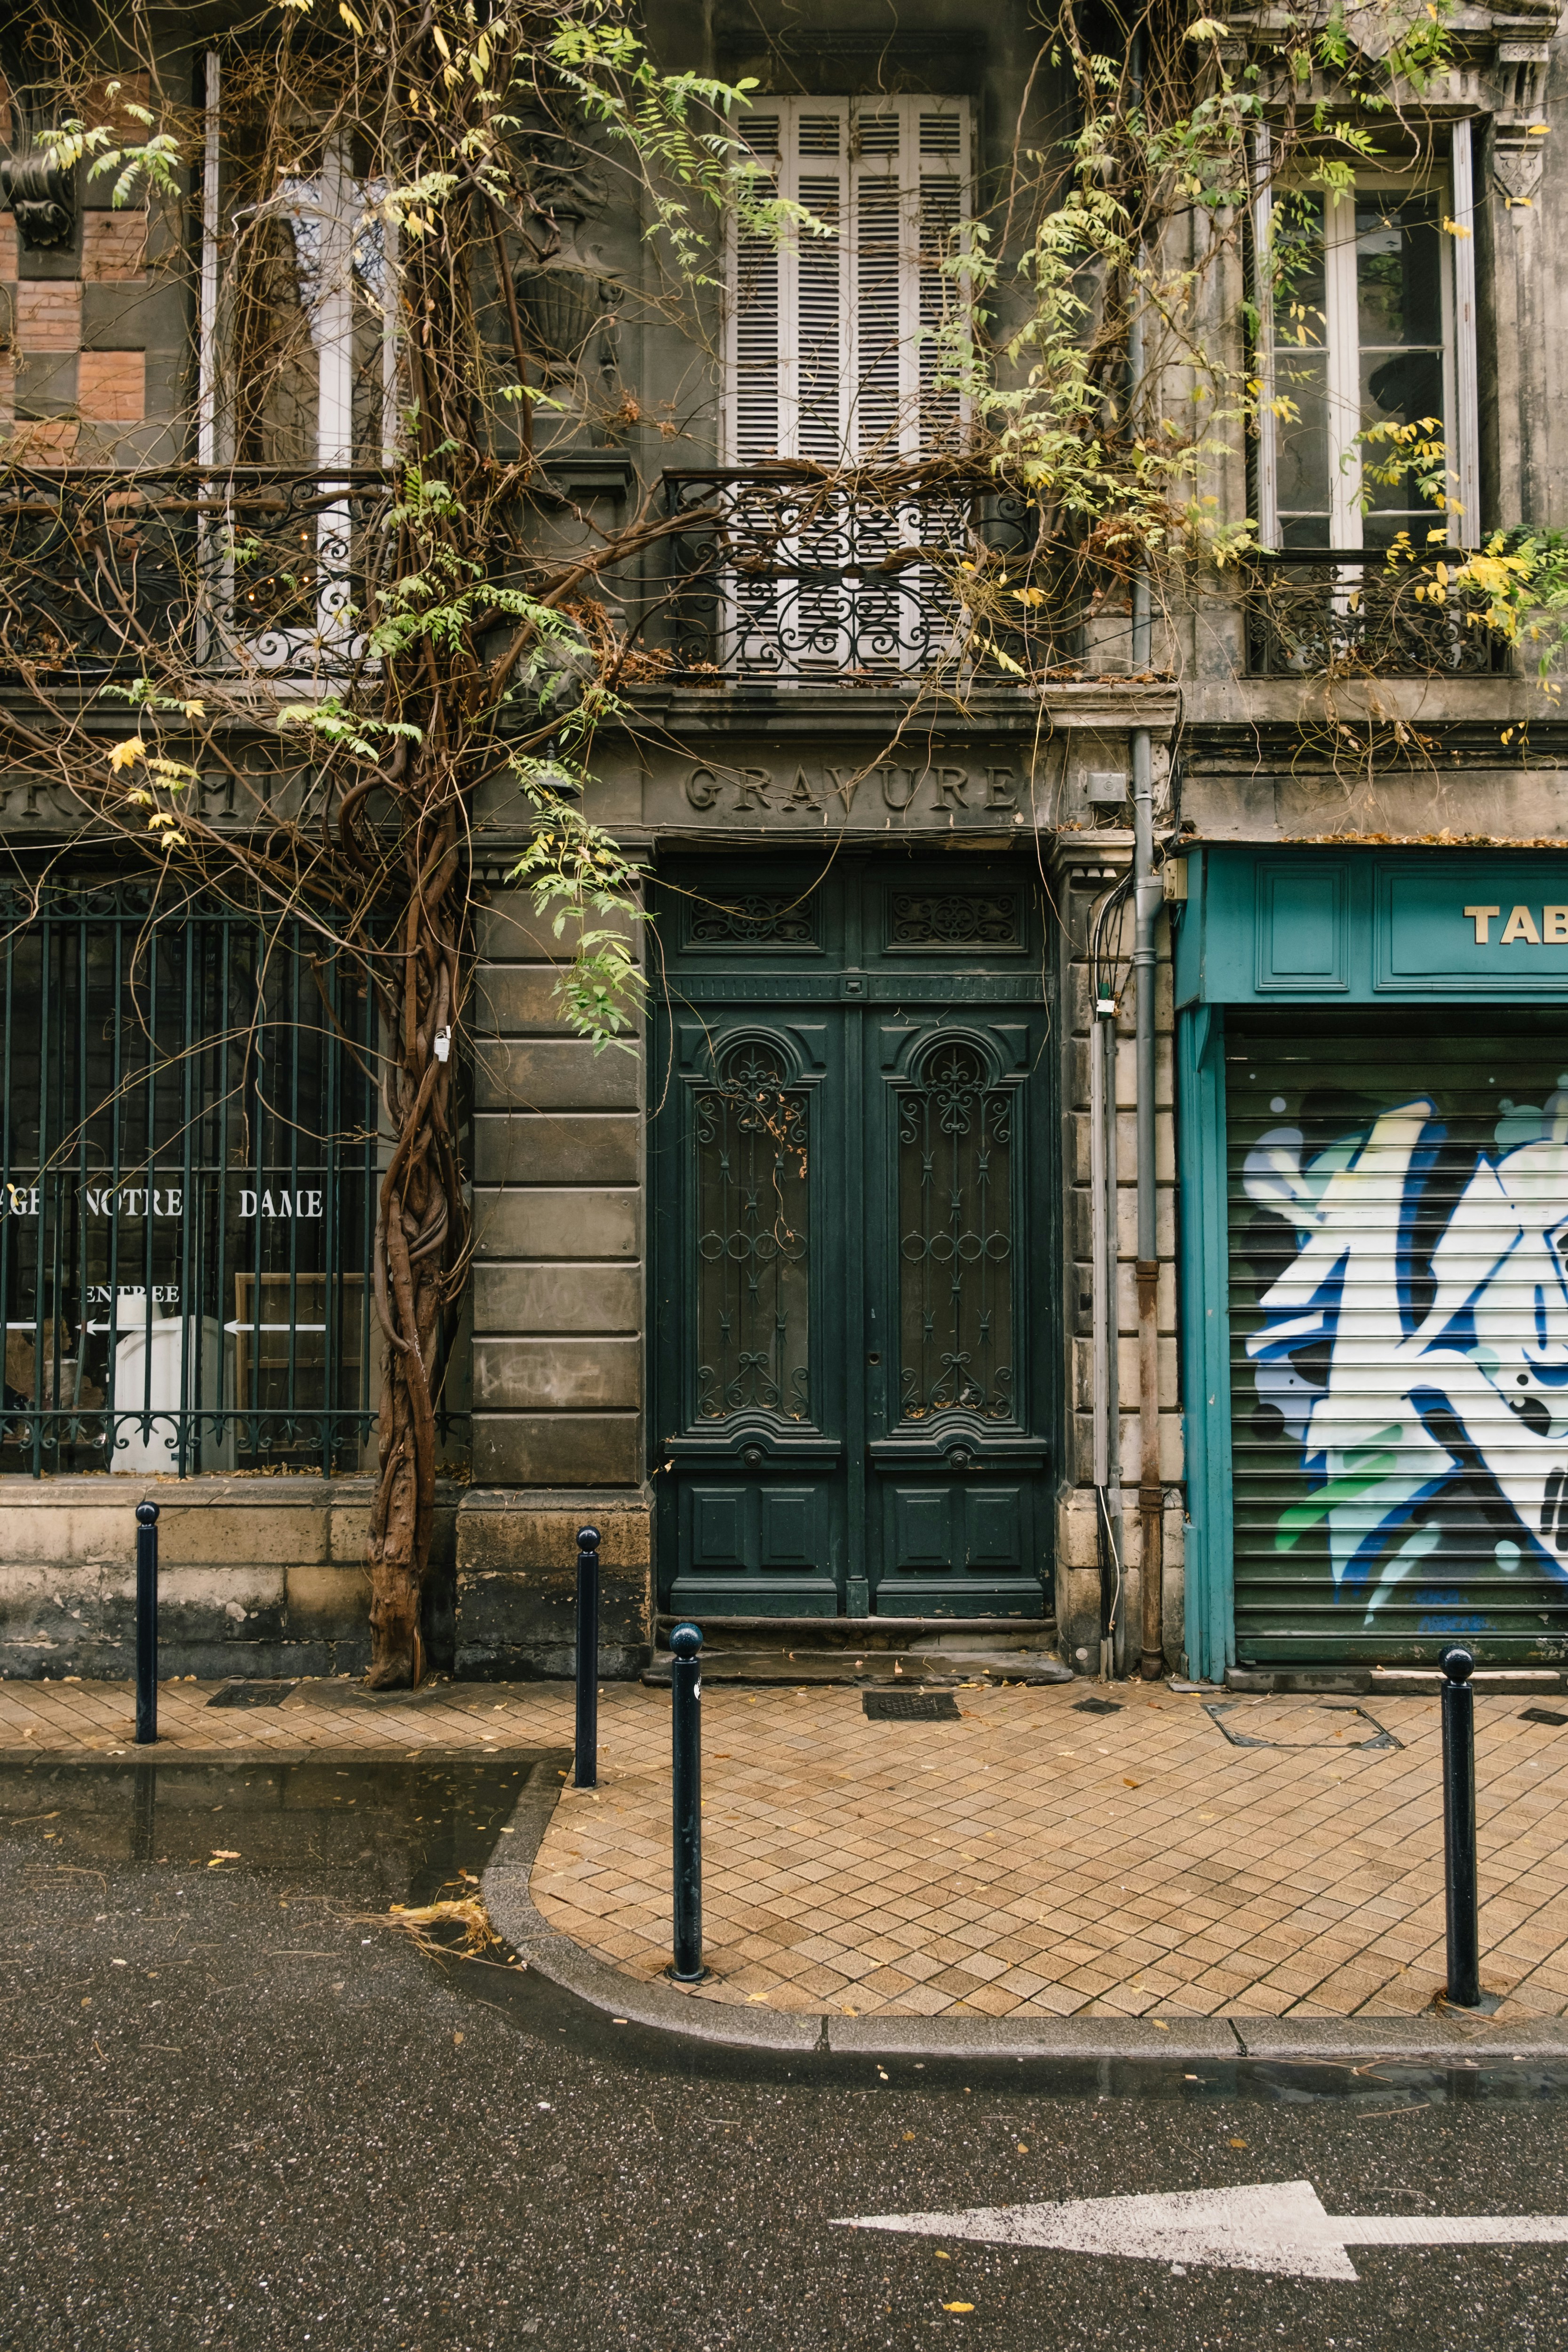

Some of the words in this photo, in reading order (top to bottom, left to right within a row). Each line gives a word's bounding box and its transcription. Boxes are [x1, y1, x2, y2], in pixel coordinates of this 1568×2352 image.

[685, 765, 1017, 810] GRAVURE
[1463, 906, 1568, 945] TAB
[79, 1188, 183, 1216] NOTRE
[239, 1189, 323, 1217] DAME
[80, 1285, 180, 1303] ENTREE
